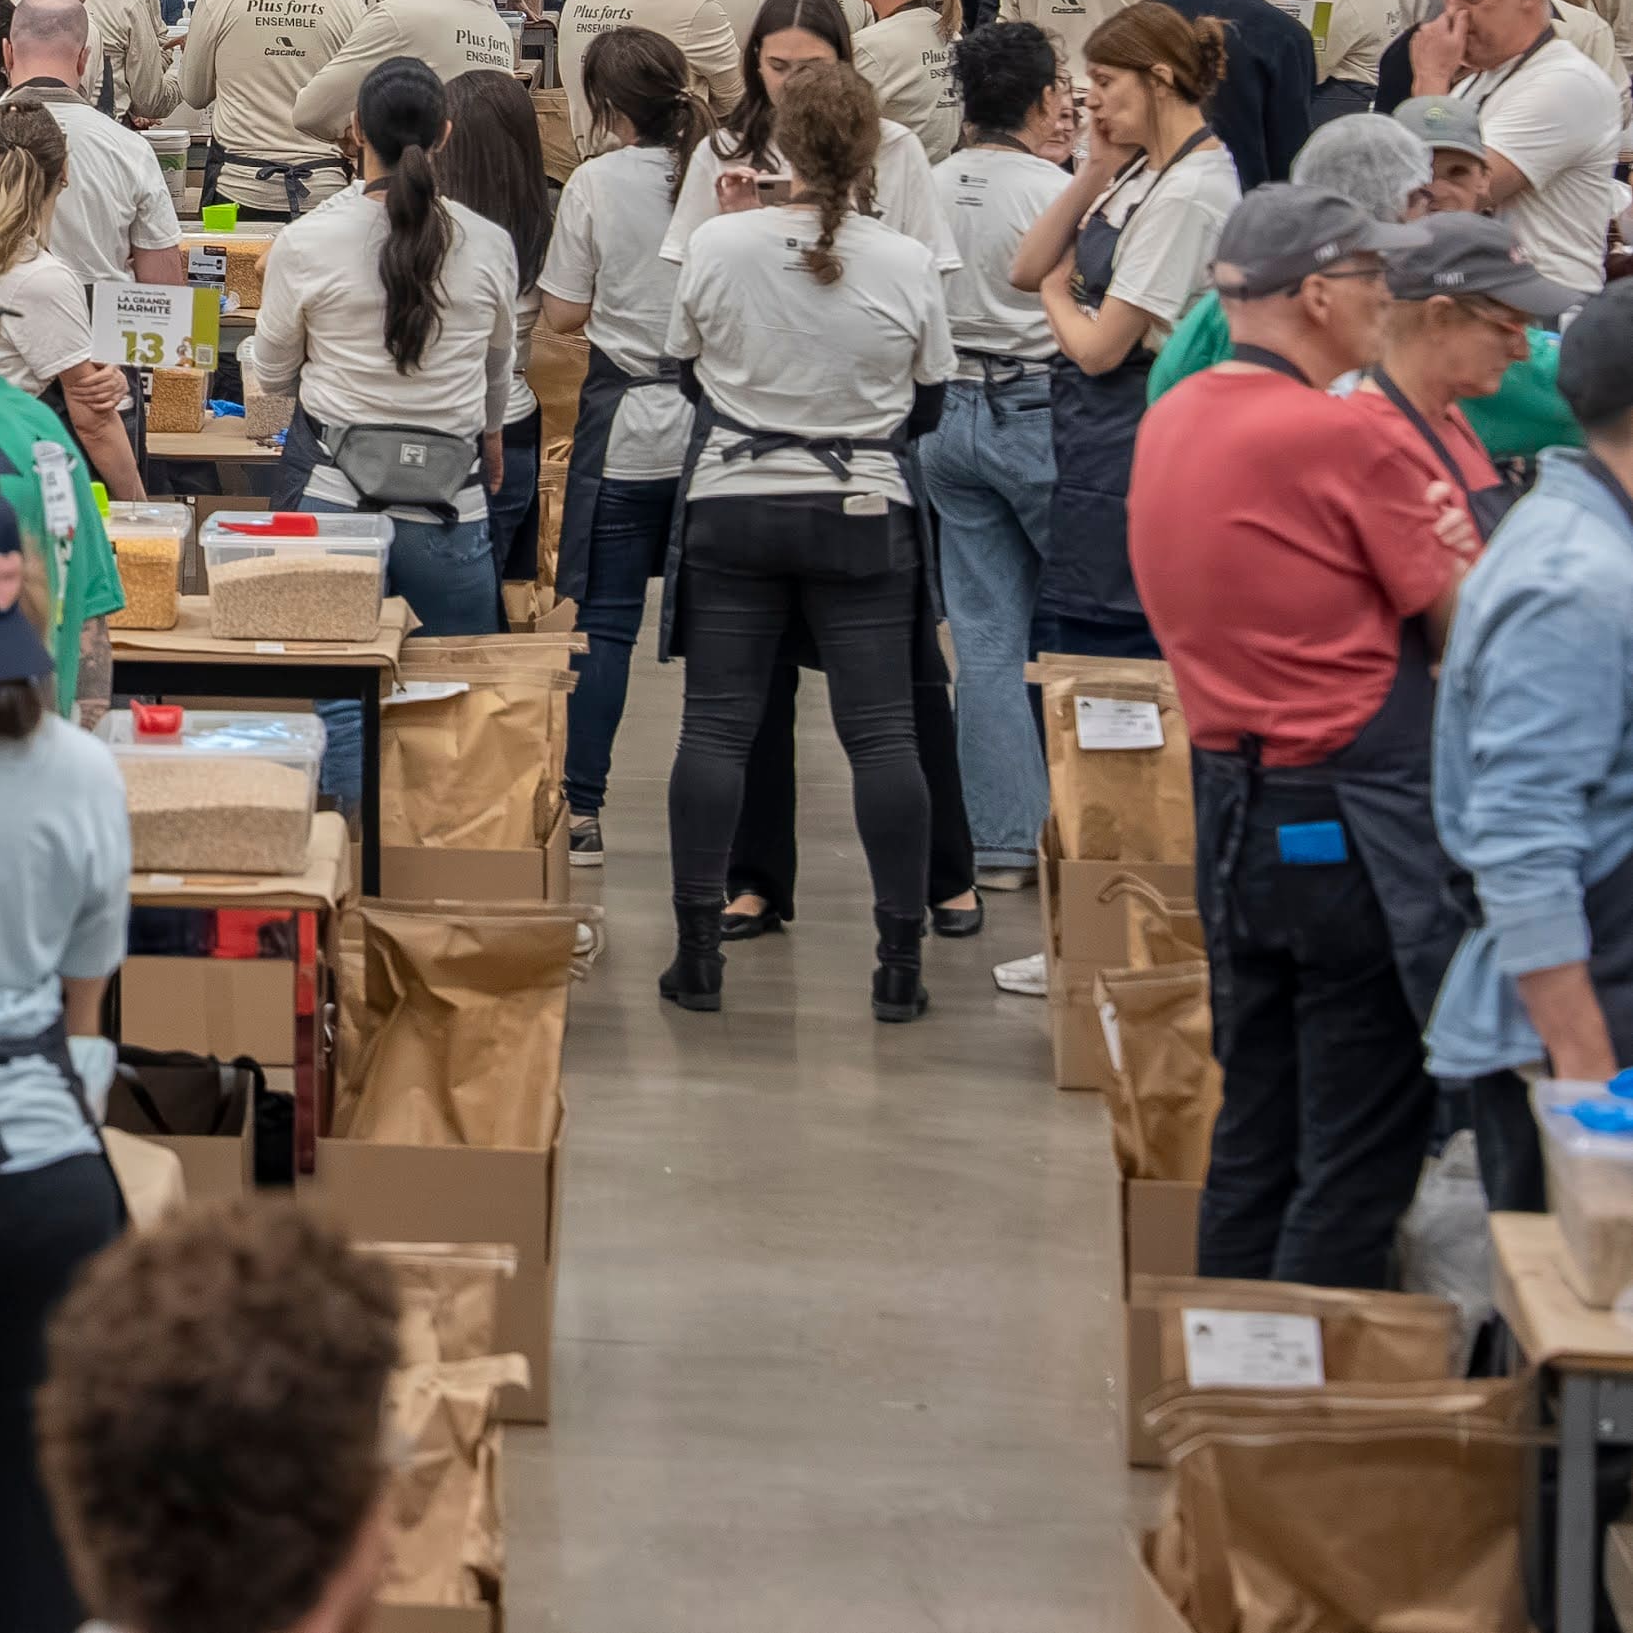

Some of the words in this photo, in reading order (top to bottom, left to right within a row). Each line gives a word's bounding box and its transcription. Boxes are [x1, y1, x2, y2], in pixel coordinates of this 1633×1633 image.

[283, 0, 325, 16] forts
[573, 4, 599, 19] Plus
[598, 5, 635, 21] forts
[255, 16, 316, 28] ENSEMBLE
[456, 29, 485, 47] Plus
[264, 47, 306, 57] Cascades
[922, 49, 946, 66] Plus
[117, 295, 130, 304] LA
[132, 296, 170, 307] GRANDE
[117, 303, 171, 315] MARMITE
[121, 330, 164, 364] 13
